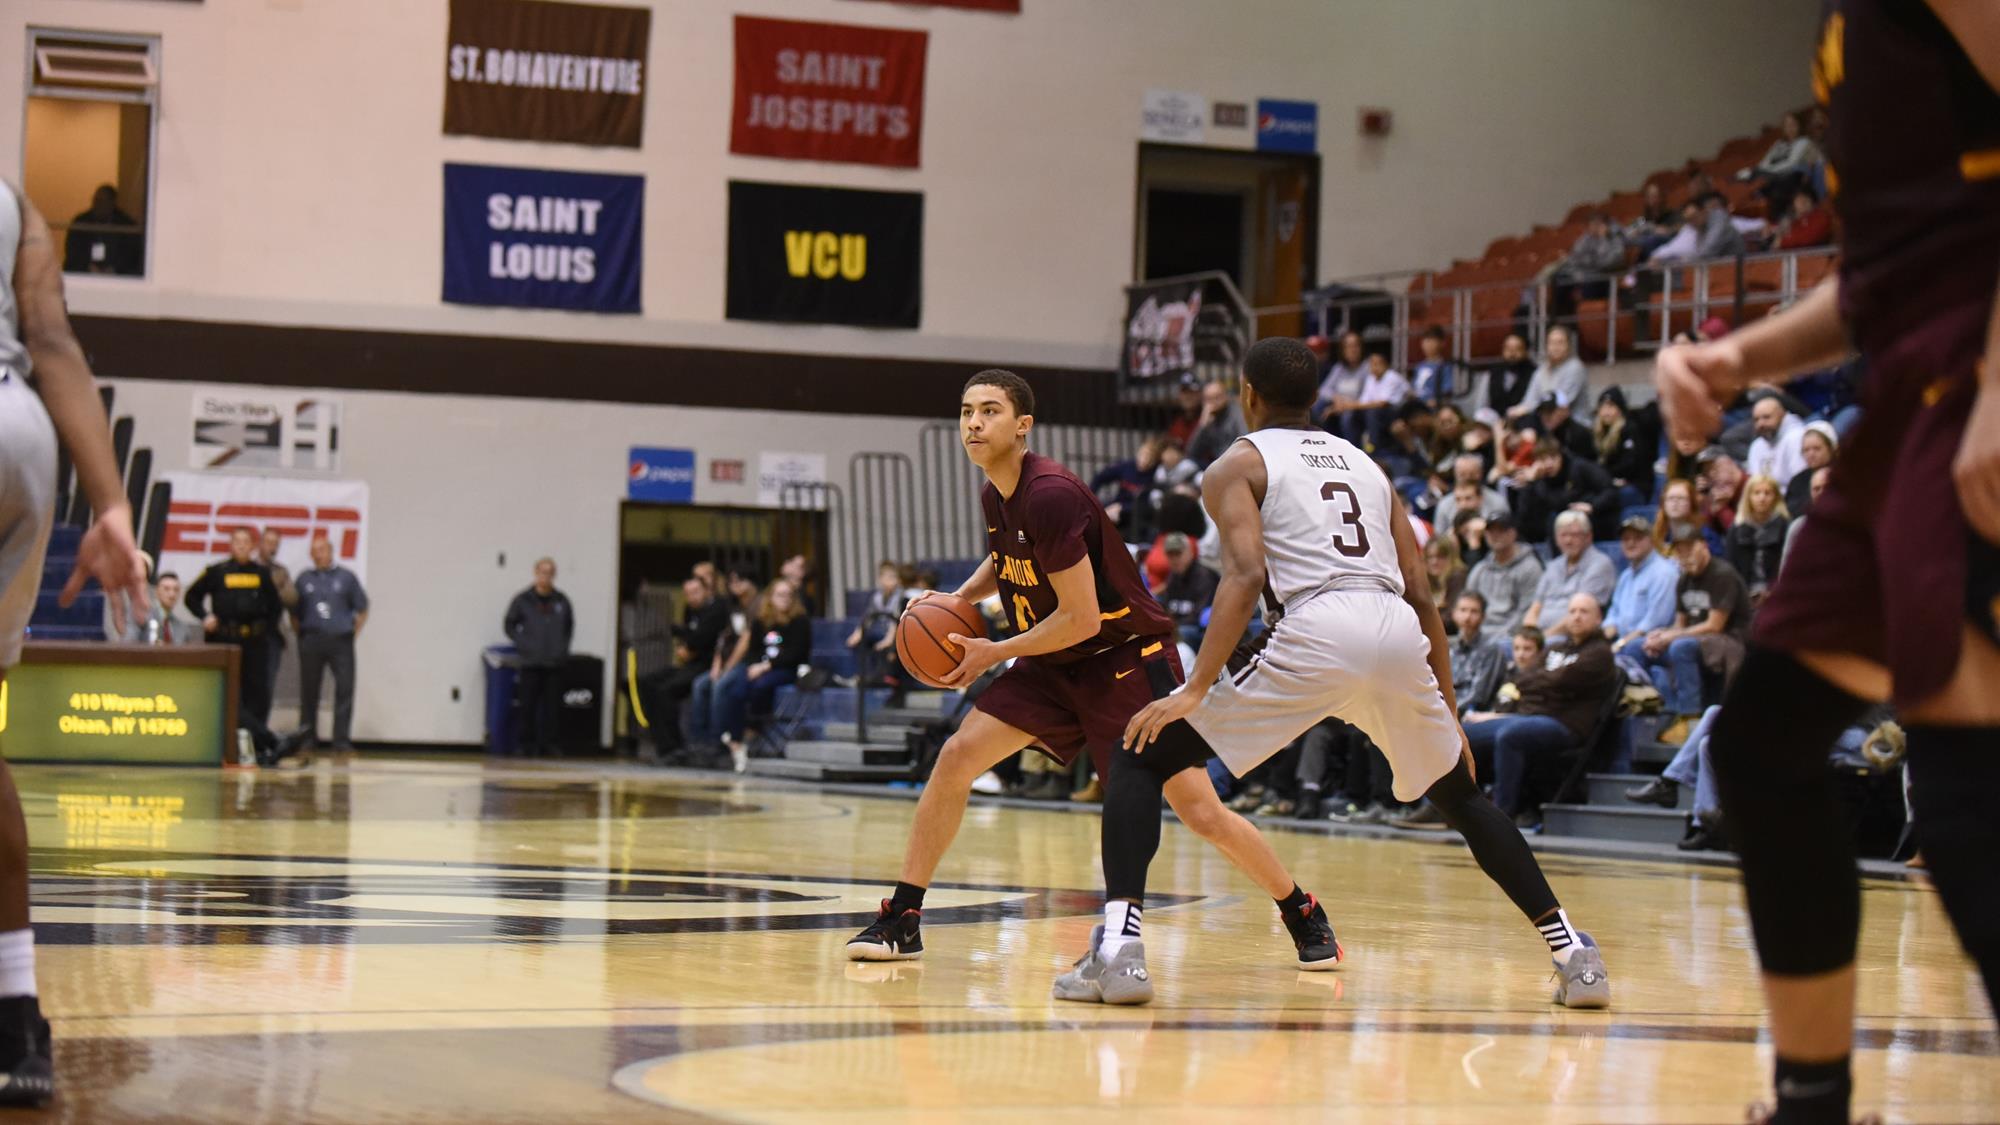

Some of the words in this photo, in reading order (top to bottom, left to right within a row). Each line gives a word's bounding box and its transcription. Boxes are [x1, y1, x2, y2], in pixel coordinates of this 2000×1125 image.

[485, 49, 641, 96] BONAVENTURE
[777, 50, 885, 91] SAINT
[748, 94, 909, 139] JOSEPH'S
[487, 194, 602, 235] SAINT
[490, 243, 596, 283] LOUIS
[785, 231, 867, 281] VCU
[1300, 453, 1351, 472] OKOLI
[161, 501, 361, 560] ESPN
[1319, 481, 1372, 559] 3
[101, 693, 154, 715] Wayne
[111, 717, 137, 735] NY
